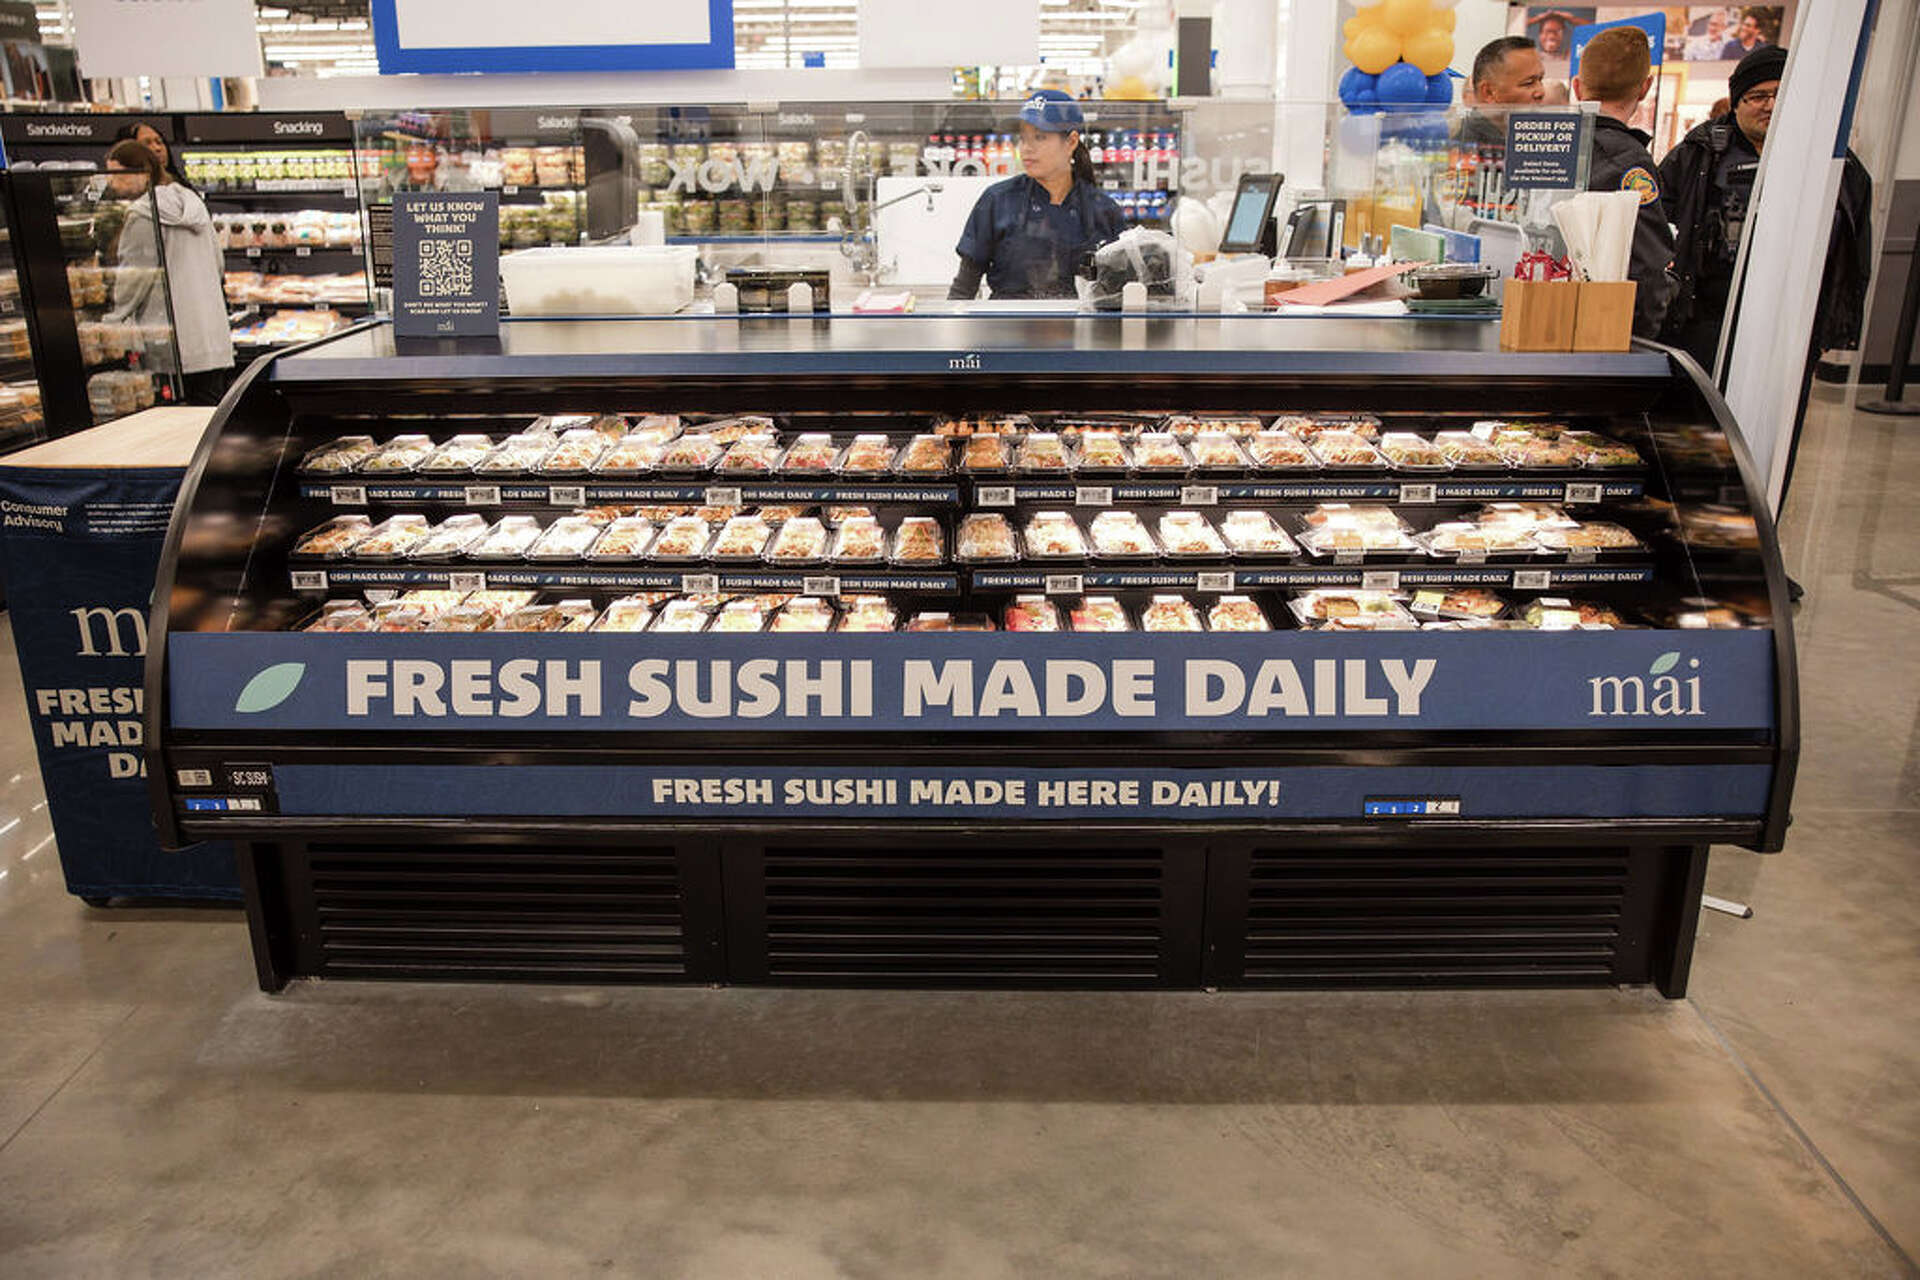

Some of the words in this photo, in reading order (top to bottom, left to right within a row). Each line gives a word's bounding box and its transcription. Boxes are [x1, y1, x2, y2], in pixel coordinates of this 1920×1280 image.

[27, 123, 93, 137] Sandwiches
[273, 121, 324, 136] Snacking
[1514, 121, 1551, 130] ORDER
[1554, 121, 1576, 130] FOR
[1515, 132, 1554, 141] PICKUP
[1557, 132, 1573, 141] OR
[1514, 143, 1571, 153] DELIVERY!
[406, 202, 427, 212] LET
[430, 202, 445, 212] US
[446, 202, 485, 212] KNOW
[414, 213, 449, 223] WHAT
[451, 213, 477, 222] YOU
[424, 224, 466, 234] THINK!
[309, 490, 330, 499] FRES
[391, 490, 417, 499] DAILY
[502, 490, 520, 499] ADE
[521, 490, 547, 499] DAILY
[626, 491, 651, 499] MADE
[653, 491, 680, 500] DAILY
[759, 492, 785, 501] MADE
[787, 492, 813, 500] DAILY
[836, 492, 865, 501] FRESH
[866, 492, 891, 501] SUSHI
[893, 492, 920, 501] MADE
[922, 492, 949, 501] DAILY
[1040, 490, 1066, 499] MADE
[1118, 489, 1146, 499] FRESH
[1148, 489, 1174, 499] SUSHI
[1254, 489, 1282, 499] FRESH
[1284, 489, 1310, 499] SUSHI
[1312, 489, 1338, 498] MADE
[1340, 489, 1366, 498] DAILY
[1446, 488, 1472, 497] MADE
[1473, 488, 1500, 497] DAILY
[1522, 488, 1550, 497] FRESH
[1606, 488, 1633, 497] DAILY
[1, 500, 69, 517] Consumer
[3, 514, 63, 533] Advisory
[353, 573, 378, 582] MADE
[380, 573, 405, 582] DAILY
[428, 574, 449, 582] FRES
[511, 575, 538, 583] DAILY
[561, 576, 589, 585] FRESH
[591, 576, 617, 585] SUSHI
[618, 577, 645, 586] MADE
[646, 577, 673, 586] DAILY
[982, 576, 1010, 585] FRESH
[1013, 576, 1040, 585] SUSHI
[1120, 576, 1150, 585] FRESH
[1151, 576, 1178, 585] SUSHI
[1258, 575, 1287, 585] FRESH
[1289, 575, 1315, 584] SUSHI
[1317, 575, 1344, 584] MADE
[1425, 574, 1452, 583] SUSHI
[1453, 574, 1480, 582] MADE
[1482, 574, 1509, 582] DAILY
[1561, 573, 1587, 582] SUSHI
[1589, 573, 1616, 581] MADE
[1618, 573, 1644, 581] DAILY
[726, 578, 752, 587] SUSHI
[754, 578, 780, 587] MADE
[863, 580, 889, 589] SUSHI
[891, 580, 918, 589] MADE
[920, 581, 947, 590] DAILY
[346, 658, 602, 718] FRESH
[627, 658, 873, 718] SUSHI
[902, 658, 1156, 718] MADE
[1185, 658, 1437, 716] DAILY
[51, 720, 144, 748] MAD
[652, 778, 773, 804] FRESH
[784, 778, 897, 805] SUSHI
[909, 779, 1026, 806] MADE
[1037, 780, 1141, 806] HERE
[1151, 780, 1281, 807] DAILY!
